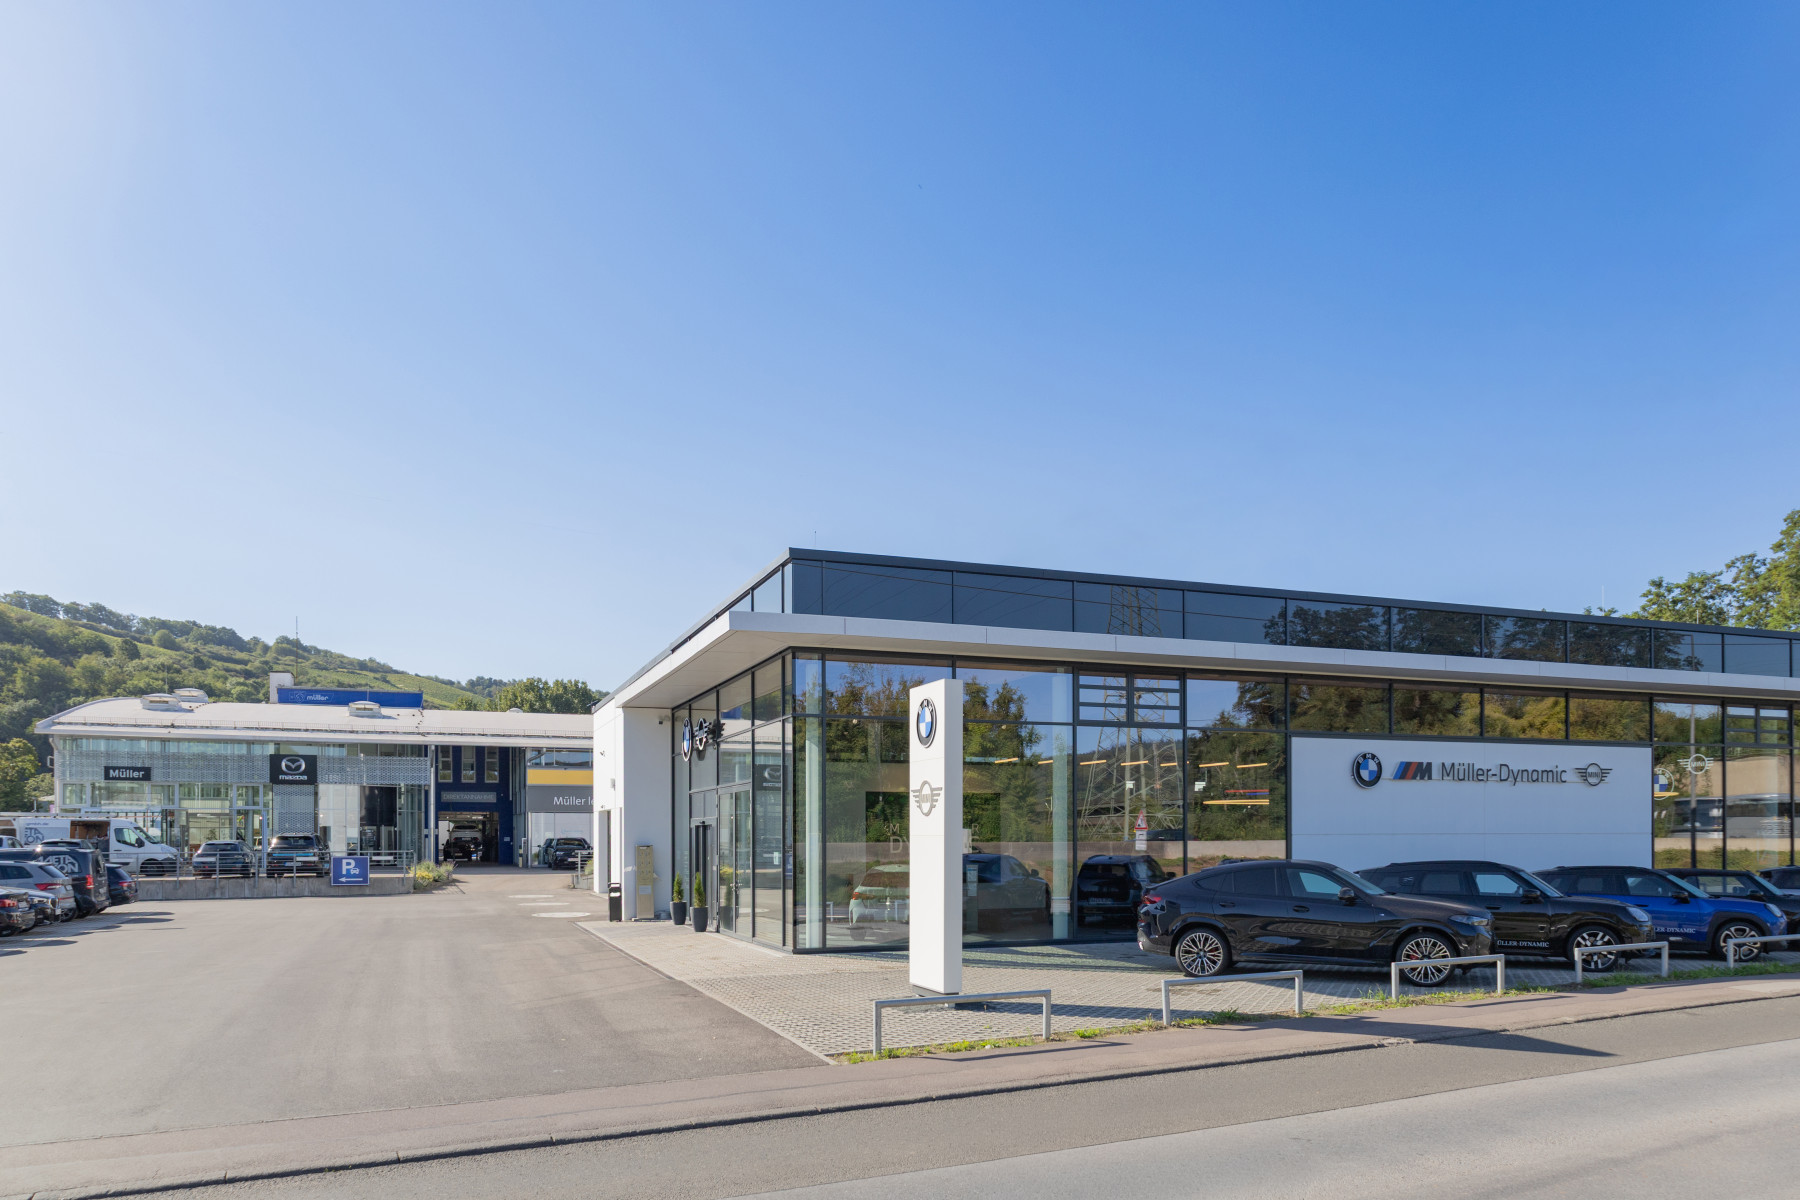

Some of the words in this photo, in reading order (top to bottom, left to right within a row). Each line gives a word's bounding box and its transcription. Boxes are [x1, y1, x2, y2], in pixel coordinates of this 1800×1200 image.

[109, 769, 144, 778] Müller
[1441, 762, 1567, 786] Müller-Dynamic
[1587, 771, 1601, 779] MINI
[553, 796, 586, 805] Müller
[341, 858, 356, 875] P
